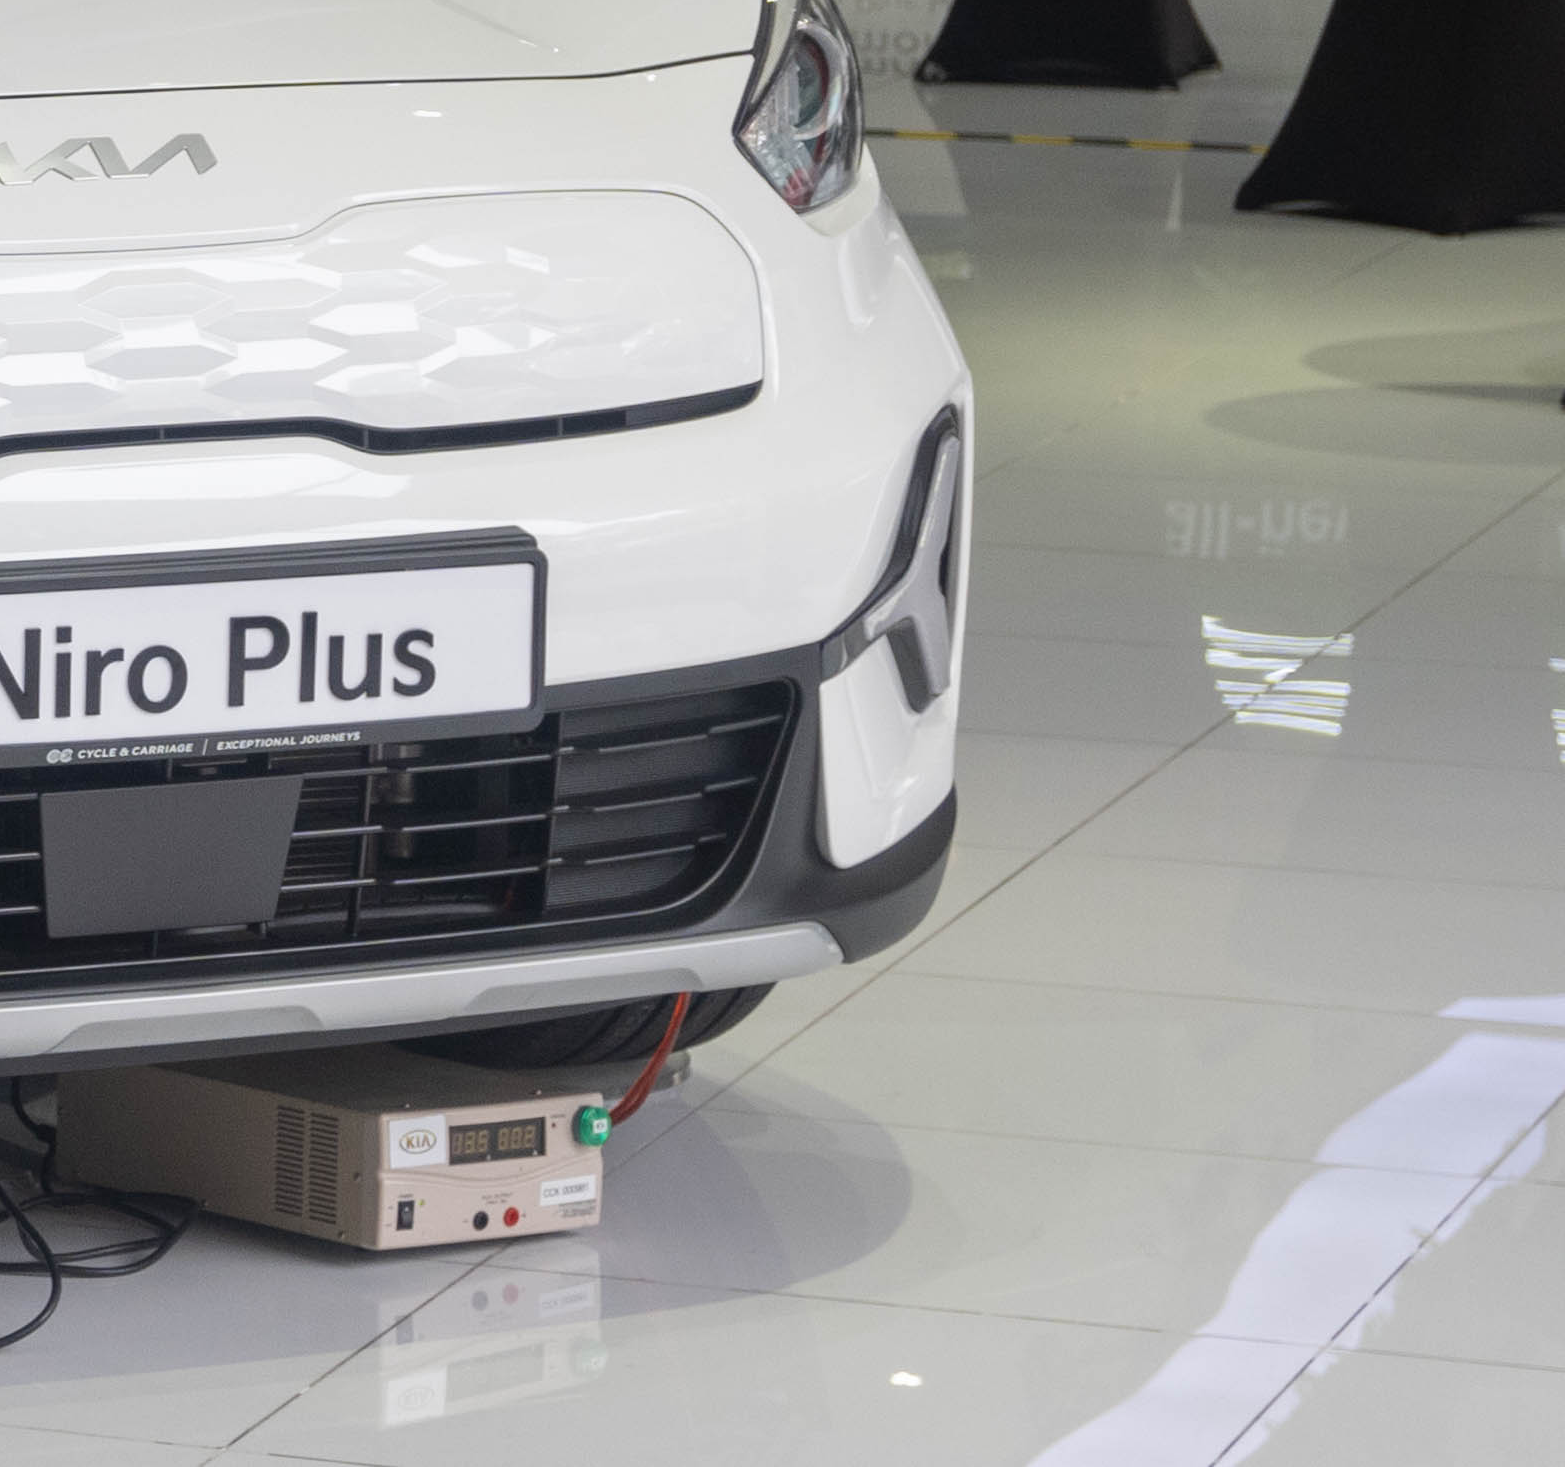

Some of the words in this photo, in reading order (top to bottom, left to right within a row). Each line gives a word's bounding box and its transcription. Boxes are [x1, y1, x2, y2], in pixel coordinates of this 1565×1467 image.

[228, 610, 436, 708] Plus
[78, 746, 117, 760] CYCLE
[119, 745, 130, 758] &
[132, 742, 193, 757] CARRIAGE
[216, 736, 297, 752] EXCEPTIONAL
[300, 731, 361, 745] JOURNEYS
[406, 1135, 431, 1150] KIA
